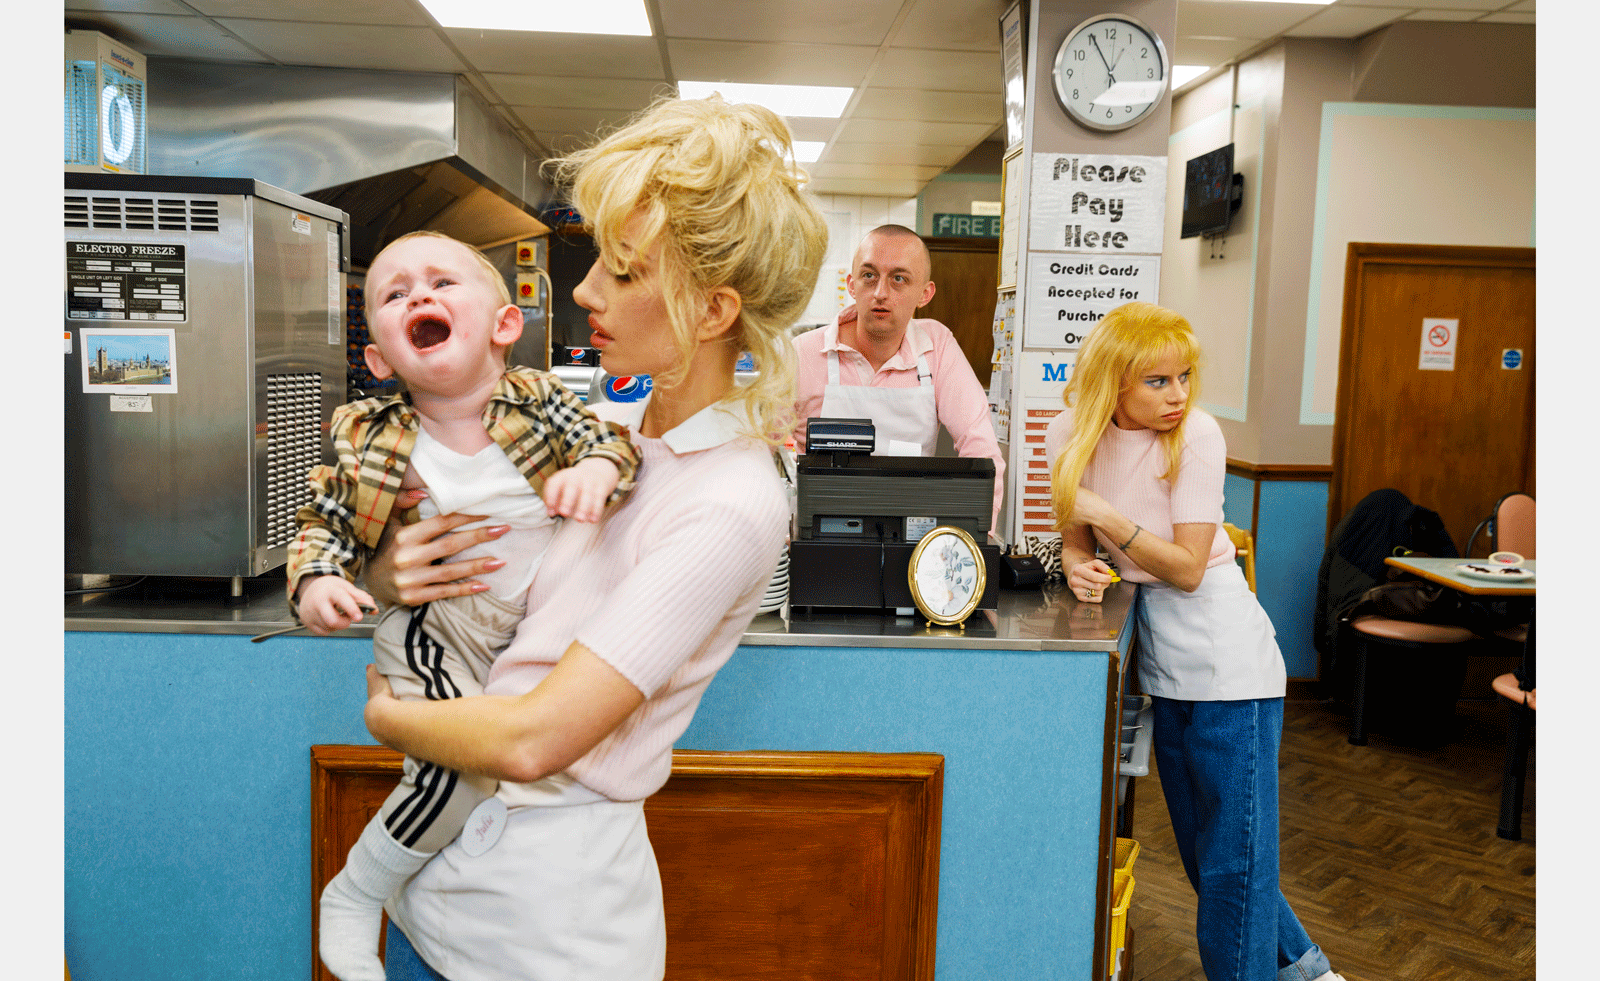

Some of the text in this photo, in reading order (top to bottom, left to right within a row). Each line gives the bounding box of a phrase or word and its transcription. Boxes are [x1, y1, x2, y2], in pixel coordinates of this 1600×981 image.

[1105, 29, 1117, 40] 12
[1073, 50, 1085, 61] 10
[1141, 48, 1148, 58] 2
[1066, 68, 1073, 79] 9
[1147, 68, 1154, 79] 3
[1072, 89, 1079, 100] 8
[1088, 102, 1095, 113] 7
[1106, 108, 1113, 119] 6
[1053, 157, 1146, 183] Please
[1071, 191, 1124, 223] Pay
[939, 216, 1001, 236] FIRE E
[1064, 224, 1129, 249] Here
[75, 244, 176, 256] ELECTRO FREEZE
[1049, 262, 1139, 277] Credit Cards
[1047, 286, 1139, 301] Accepted for
[1057, 309, 1105, 322] Purcha
[1064, 332, 1084, 345] Ov
[1042, 363, 1068, 382] M
